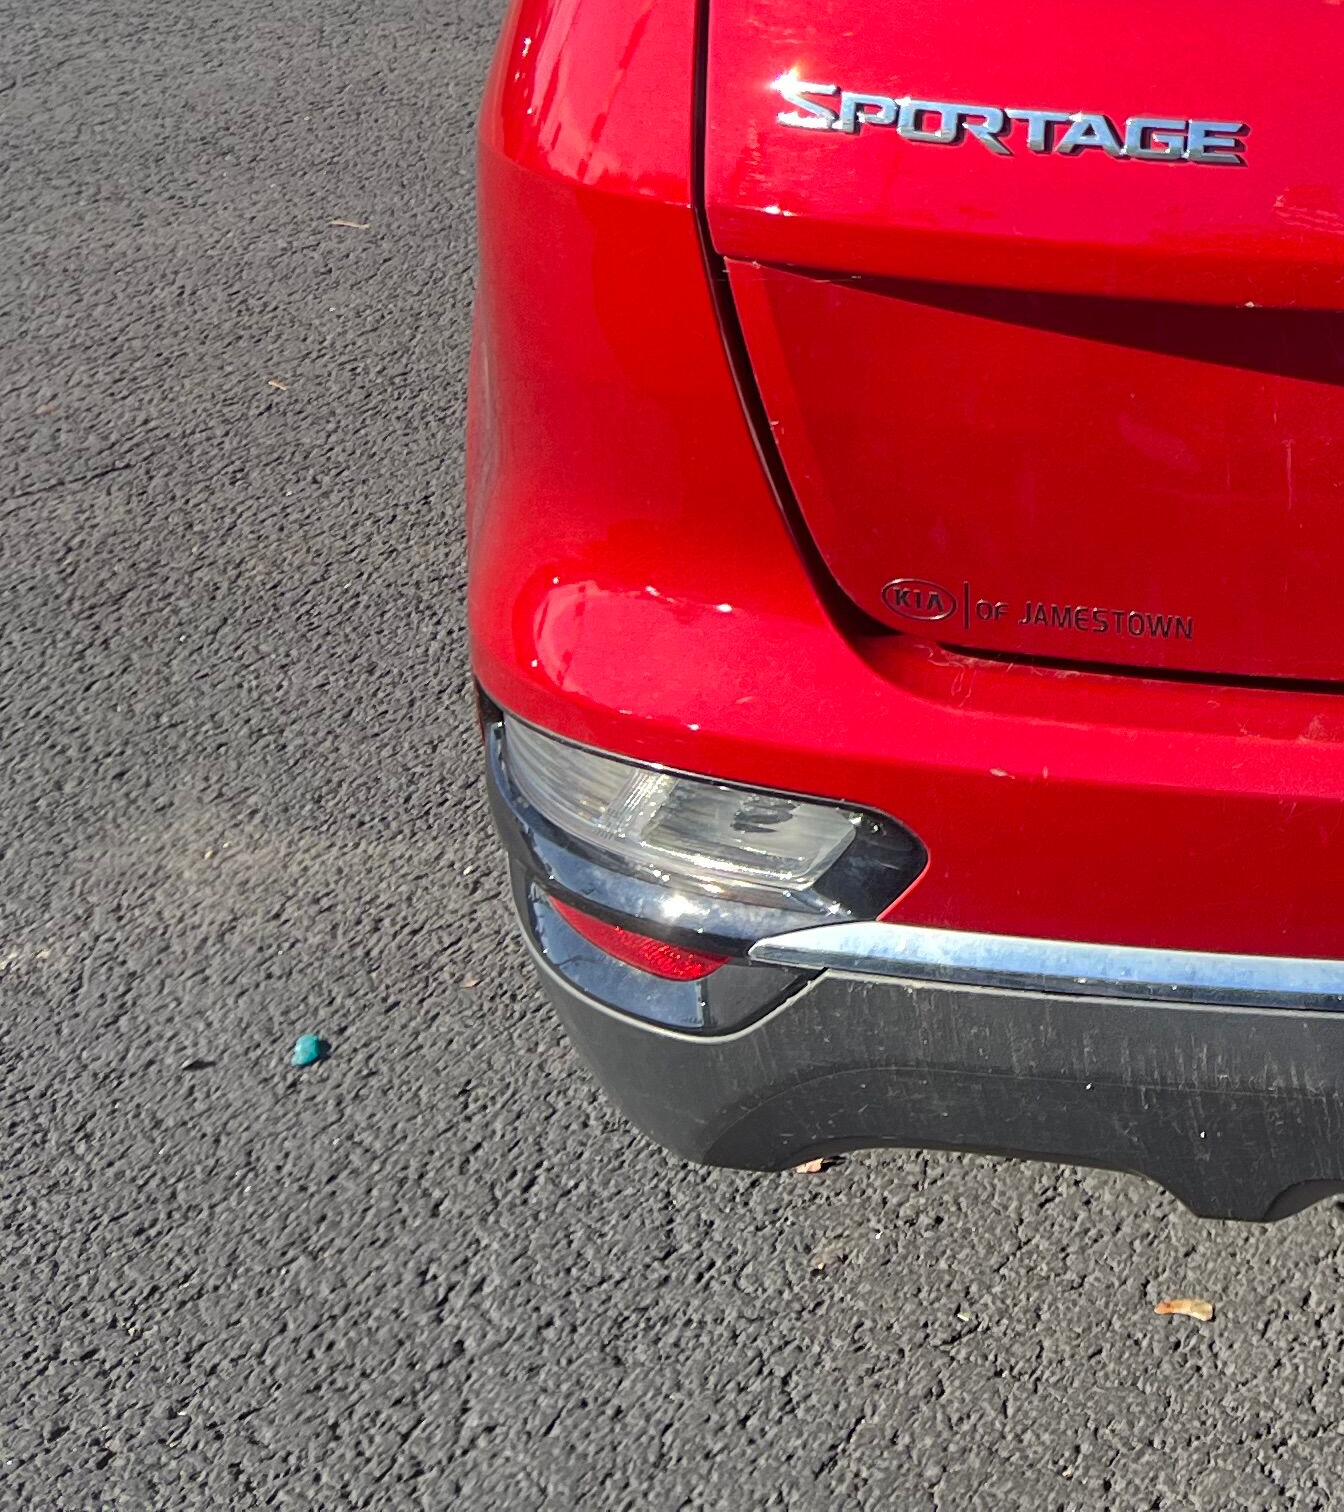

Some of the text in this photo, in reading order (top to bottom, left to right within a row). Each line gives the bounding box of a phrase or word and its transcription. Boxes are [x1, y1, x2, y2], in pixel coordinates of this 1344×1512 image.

[773, 81, 1247, 166] SPORTAGE
[893, 587, 1193, 639] KIA OF JAMESTOWN
